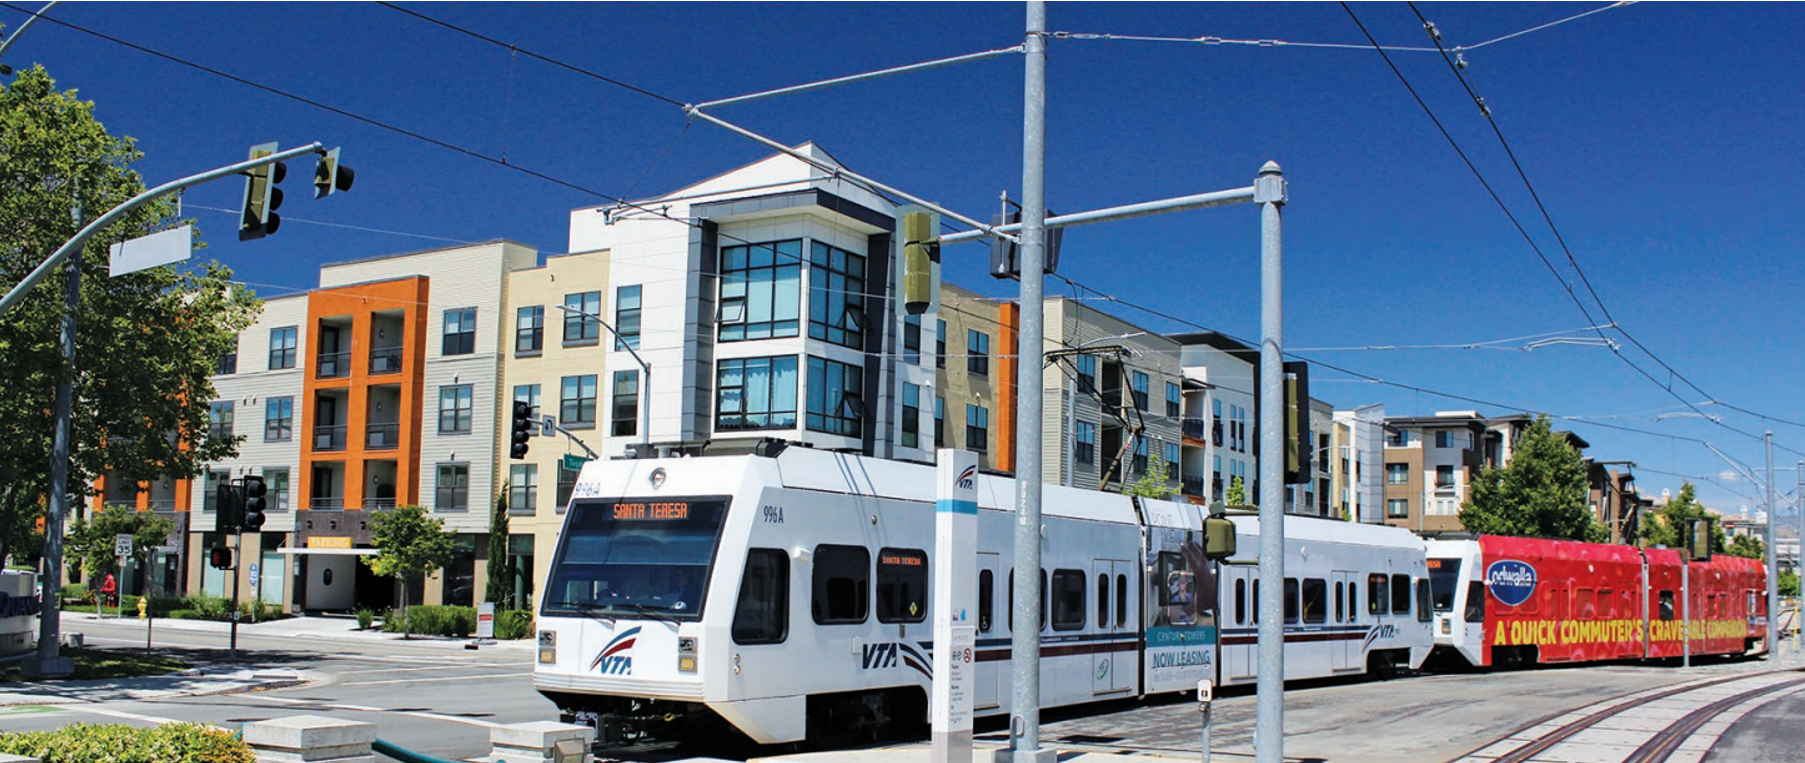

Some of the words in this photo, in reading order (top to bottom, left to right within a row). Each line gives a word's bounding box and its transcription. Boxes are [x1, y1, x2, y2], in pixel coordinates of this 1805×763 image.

[575, 482, 601, 496] 996A
[959, 478, 973, 489] VTA
[613, 503, 645, 519] SANTA
[649, 502, 688, 519] TERESA
[763, 504, 784, 524] 996A
[117, 545, 131, 554] 35
[310, 537, 349, 547] PARKING
[1491, 565, 1532, 587] odwalla
[1381, 624, 1395, 639] VTA
[1494, 620, 1506, 646] A
[1511, 620, 1557, 646] QUICK
[1561, 619, 1644, 644] COMMUTER'S
[862, 642, 898, 670] VTA
[1153, 652, 1175, 668] NOW
[1177, 650, 1210, 666] LEASING
[600, 655, 632, 676] VTA
